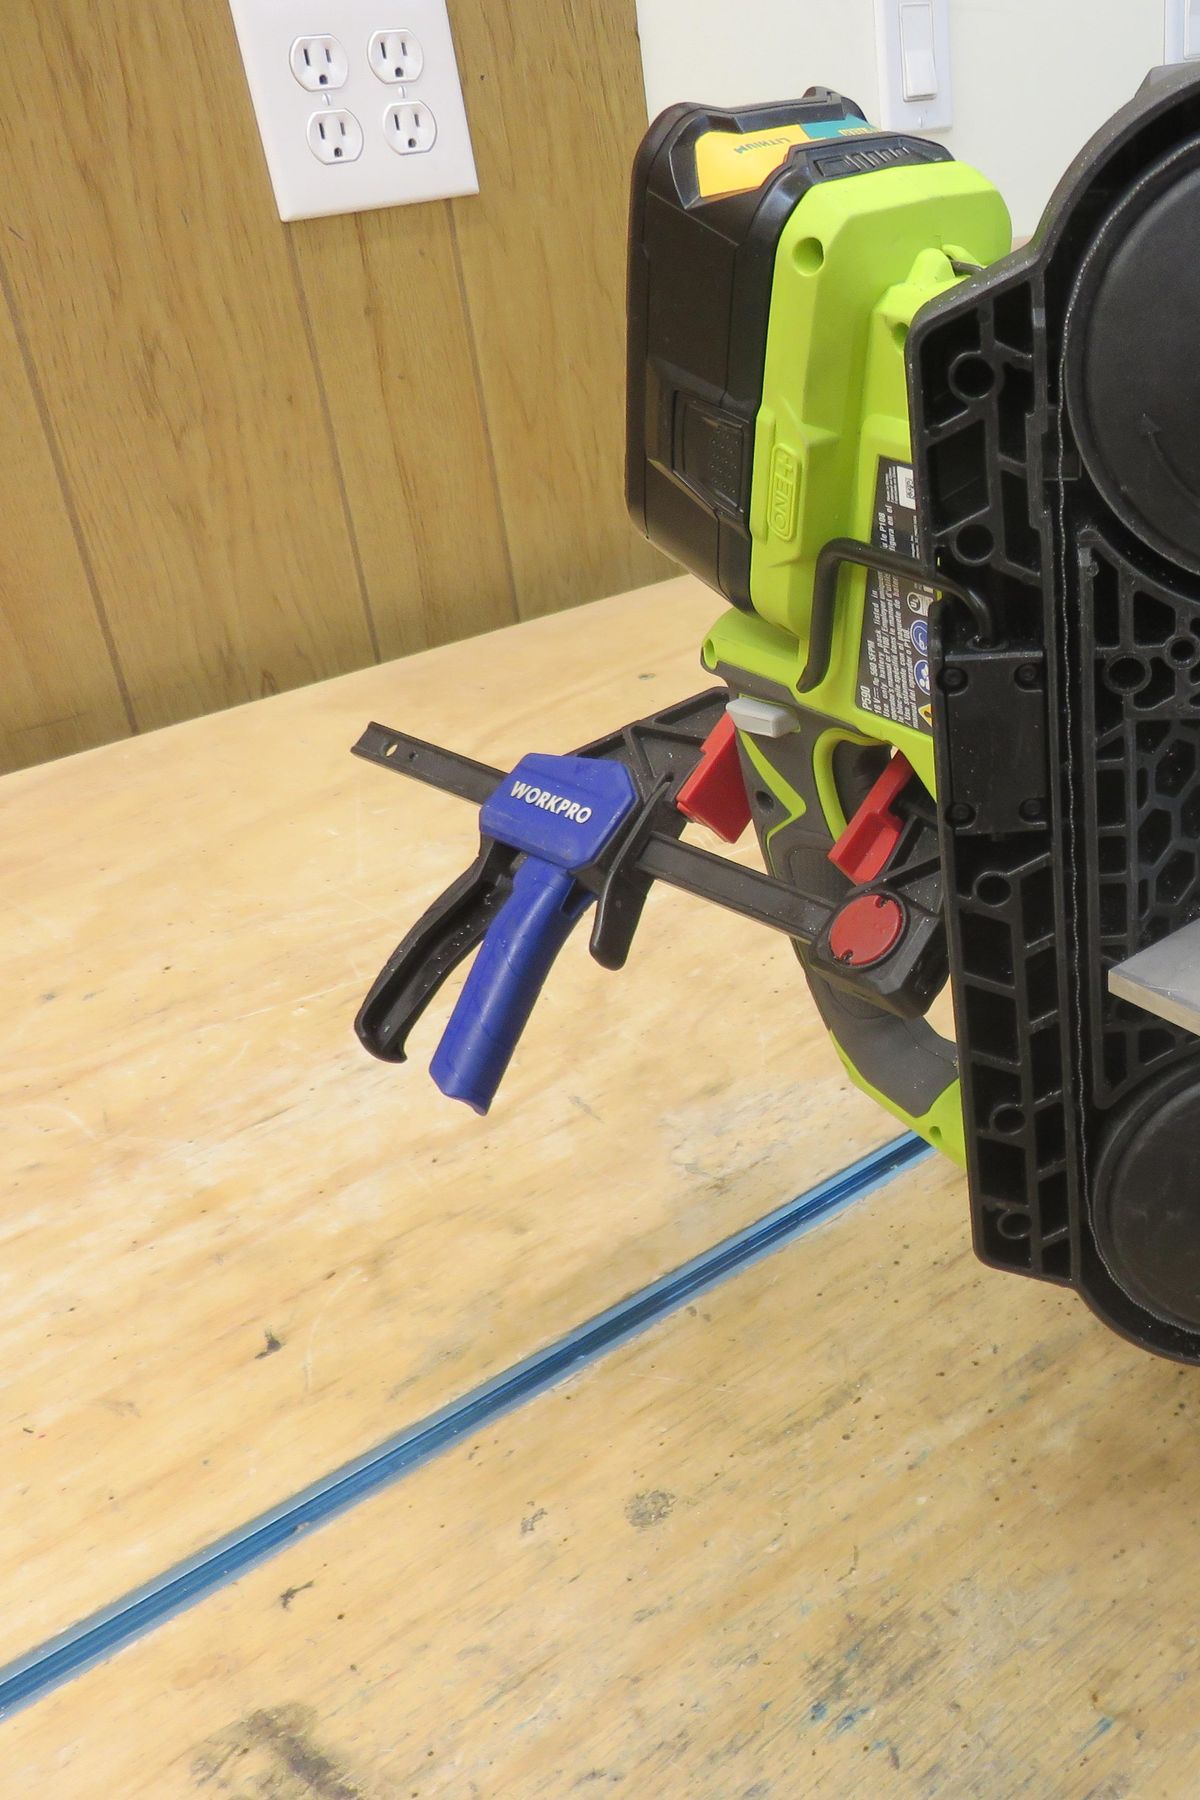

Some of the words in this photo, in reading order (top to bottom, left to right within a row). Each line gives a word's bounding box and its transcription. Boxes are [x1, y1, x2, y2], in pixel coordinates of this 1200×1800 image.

[734, 137, 791, 154] LITHIUM
[775, 457, 794, 530] ONE+
[885, 504, 892, 513] el
[878, 512, 886, 532] P108
[887, 515, 893, 526] en
[880, 533, 887, 541] le
[887, 528, 896, 551] figura
[872, 590, 878, 598] in
[894, 599, 900, 609] de
[872, 602, 880, 625] listed
[875, 629, 883, 647] pack
[889, 627, 895, 635] le
[867, 639, 876, 661] SFPM
[882, 636, 890, 654] P108
[878, 651, 887, 678] battery
[885, 654, 891, 662] or
[869, 662, 878, 676] 560
[885, 662, 893, 687] manual
[860, 685, 872, 710] P590
[874, 704, 881, 713] 18
[510, 780, 593, 825] WORKPRO
